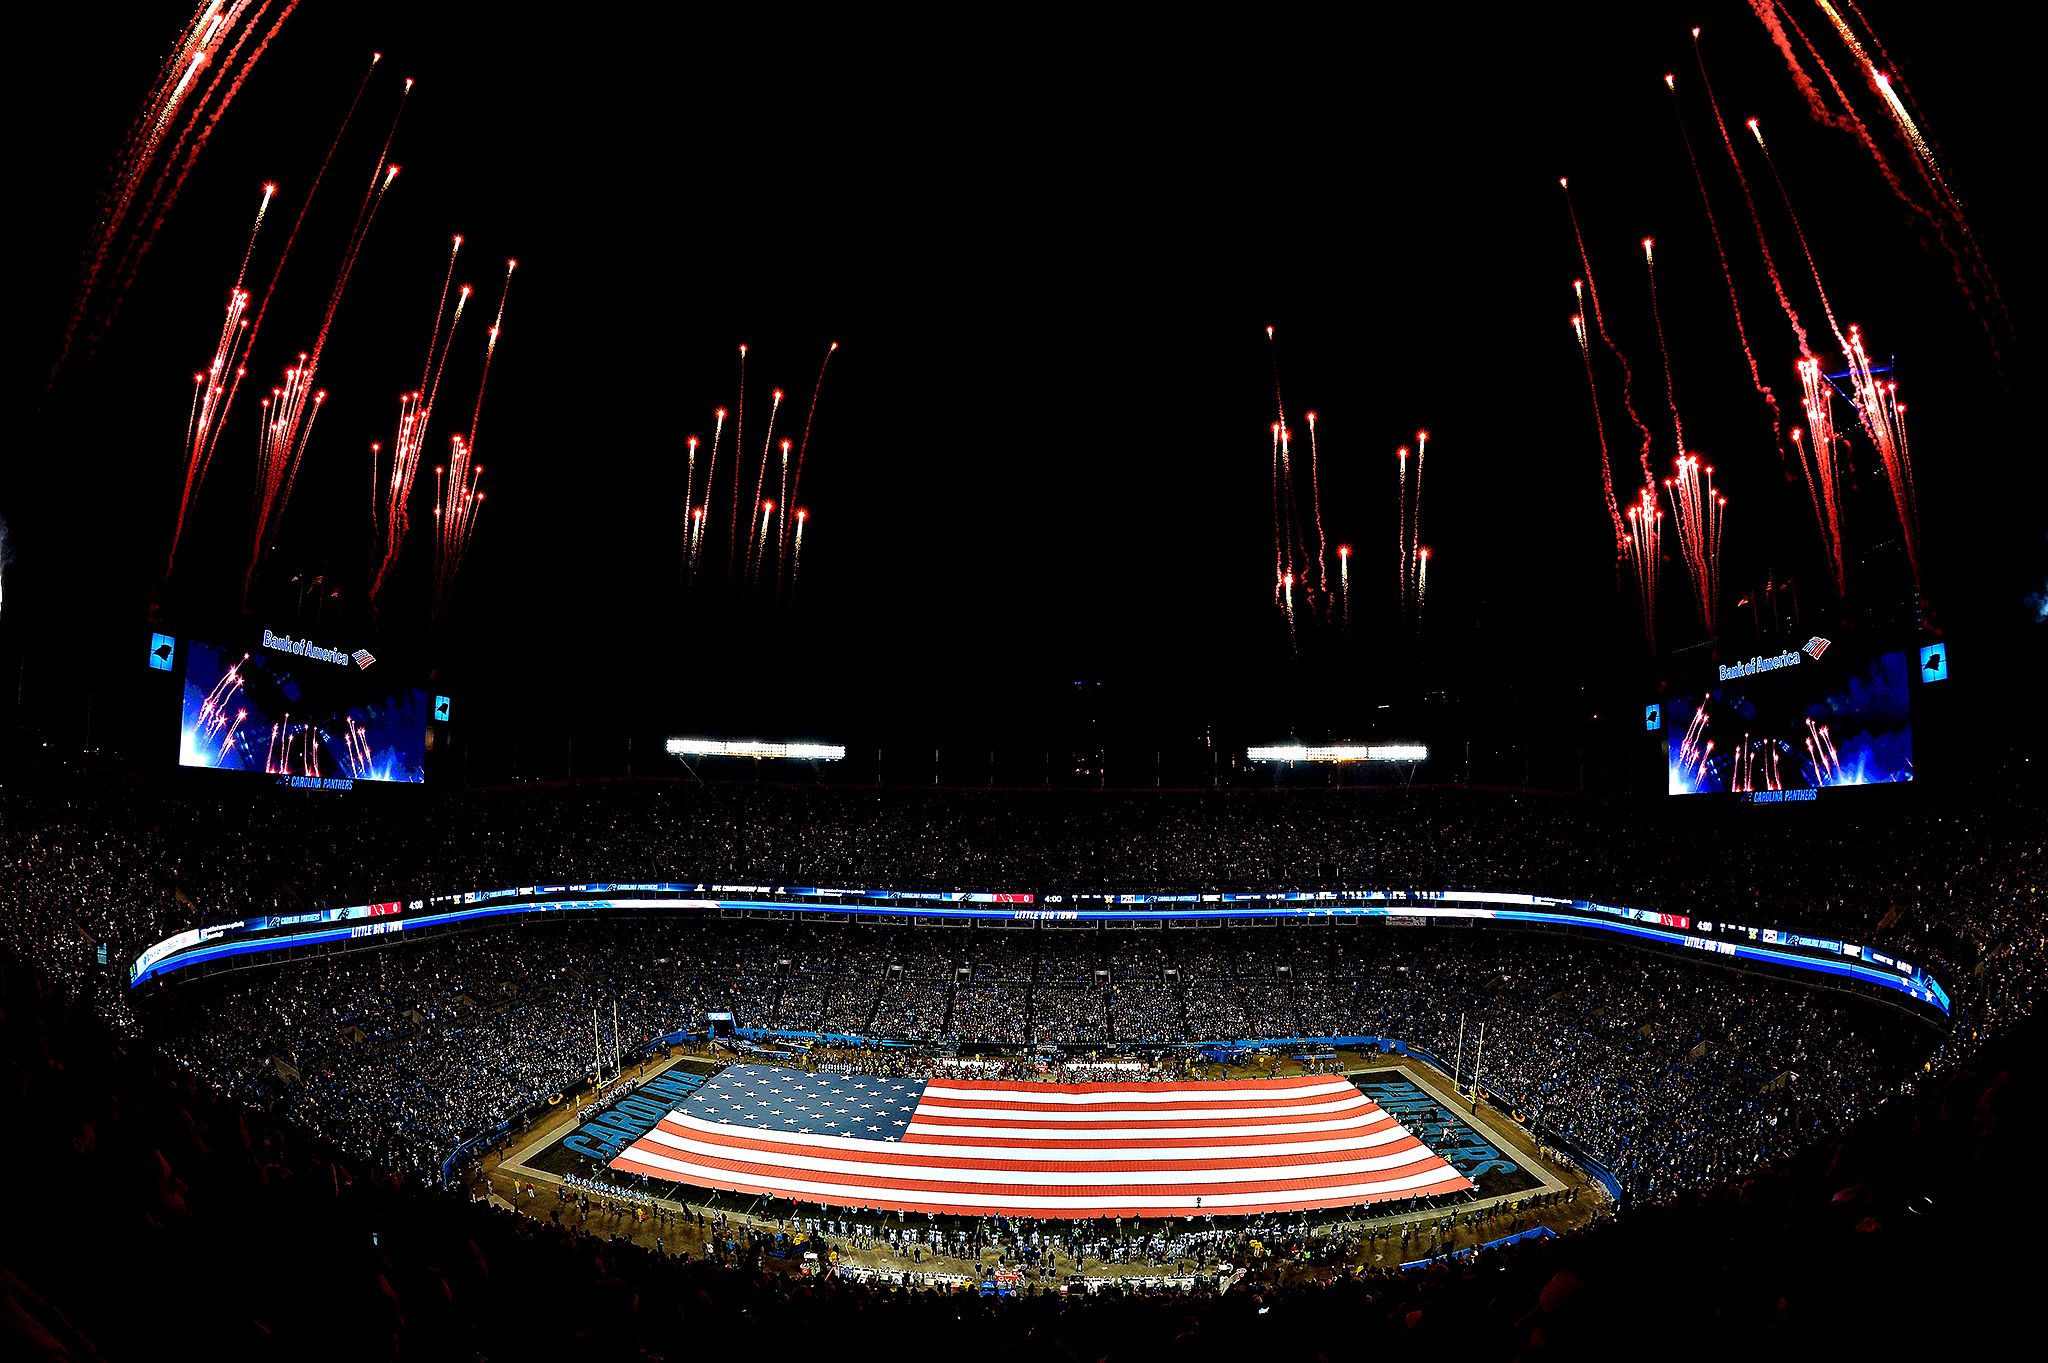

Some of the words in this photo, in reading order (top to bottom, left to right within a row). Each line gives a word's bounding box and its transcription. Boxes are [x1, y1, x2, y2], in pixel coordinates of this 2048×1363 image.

[263, 629, 292, 653] Bank
[292, 639, 306, 656] of
[304, 640, 349, 666] America
[1719, 664, 1746, 681] Bank
[1745, 657, 1756, 676] of
[1756, 650, 1801, 674] America
[291, 775, 322, 789] CAROLINA
[322, 778, 354, 791] PANTHERS
[1753, 791, 1783, 803] CAROLINA
[1784, 788, 1818, 802] PANTHERS
[408, 899, 424, 911] 4:00
[1023, 894, 1030, 903] 0
[1043, 894, 1063, 903] 4:00
[392, 902, 399, 913] 0
[1014, 910, 1040, 920] LITTLE
[1040, 911, 1055, 920] BIG
[1056, 911, 1079, 920] TOWN
[351, 924, 375, 938] LITTLE
[373, 922, 387, 935] BIG
[386, 920, 403, 933] TOWN
[1680, 917, 1687, 928] 0
[1696, 920, 1713, 932] 4:00
[1683, 935, 1706, 950] LITTLE
[1716, 941, 1737, 956] TOWN
[563, 1068, 708, 1161] CAROLINA
[1355, 1081, 1518, 1178] PANTHERS
